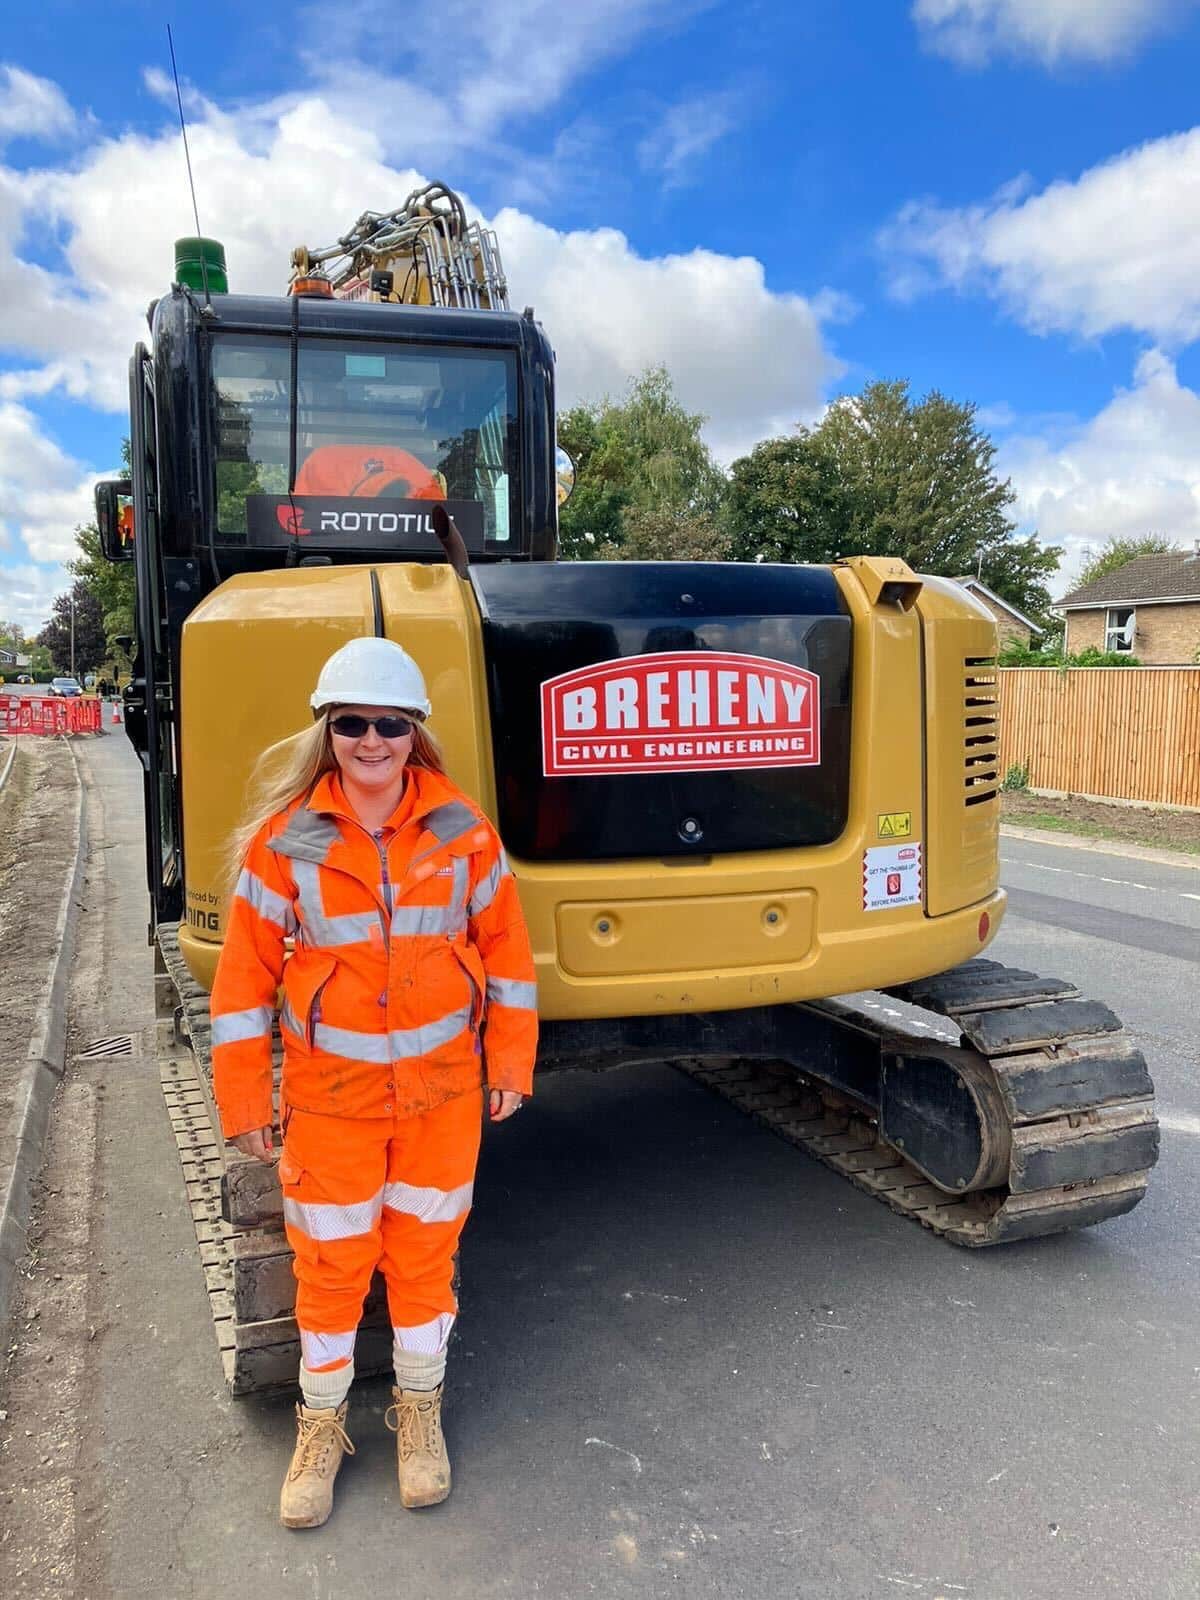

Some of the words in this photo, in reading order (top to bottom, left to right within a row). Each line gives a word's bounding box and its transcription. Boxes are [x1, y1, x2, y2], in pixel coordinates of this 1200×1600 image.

[320, 511, 454, 534] ROTOTIL
[562, 669, 808, 731] BREHENY
[562, 744, 632, 760] CIVIL
[643, 736, 806, 757] ENGINEERING
